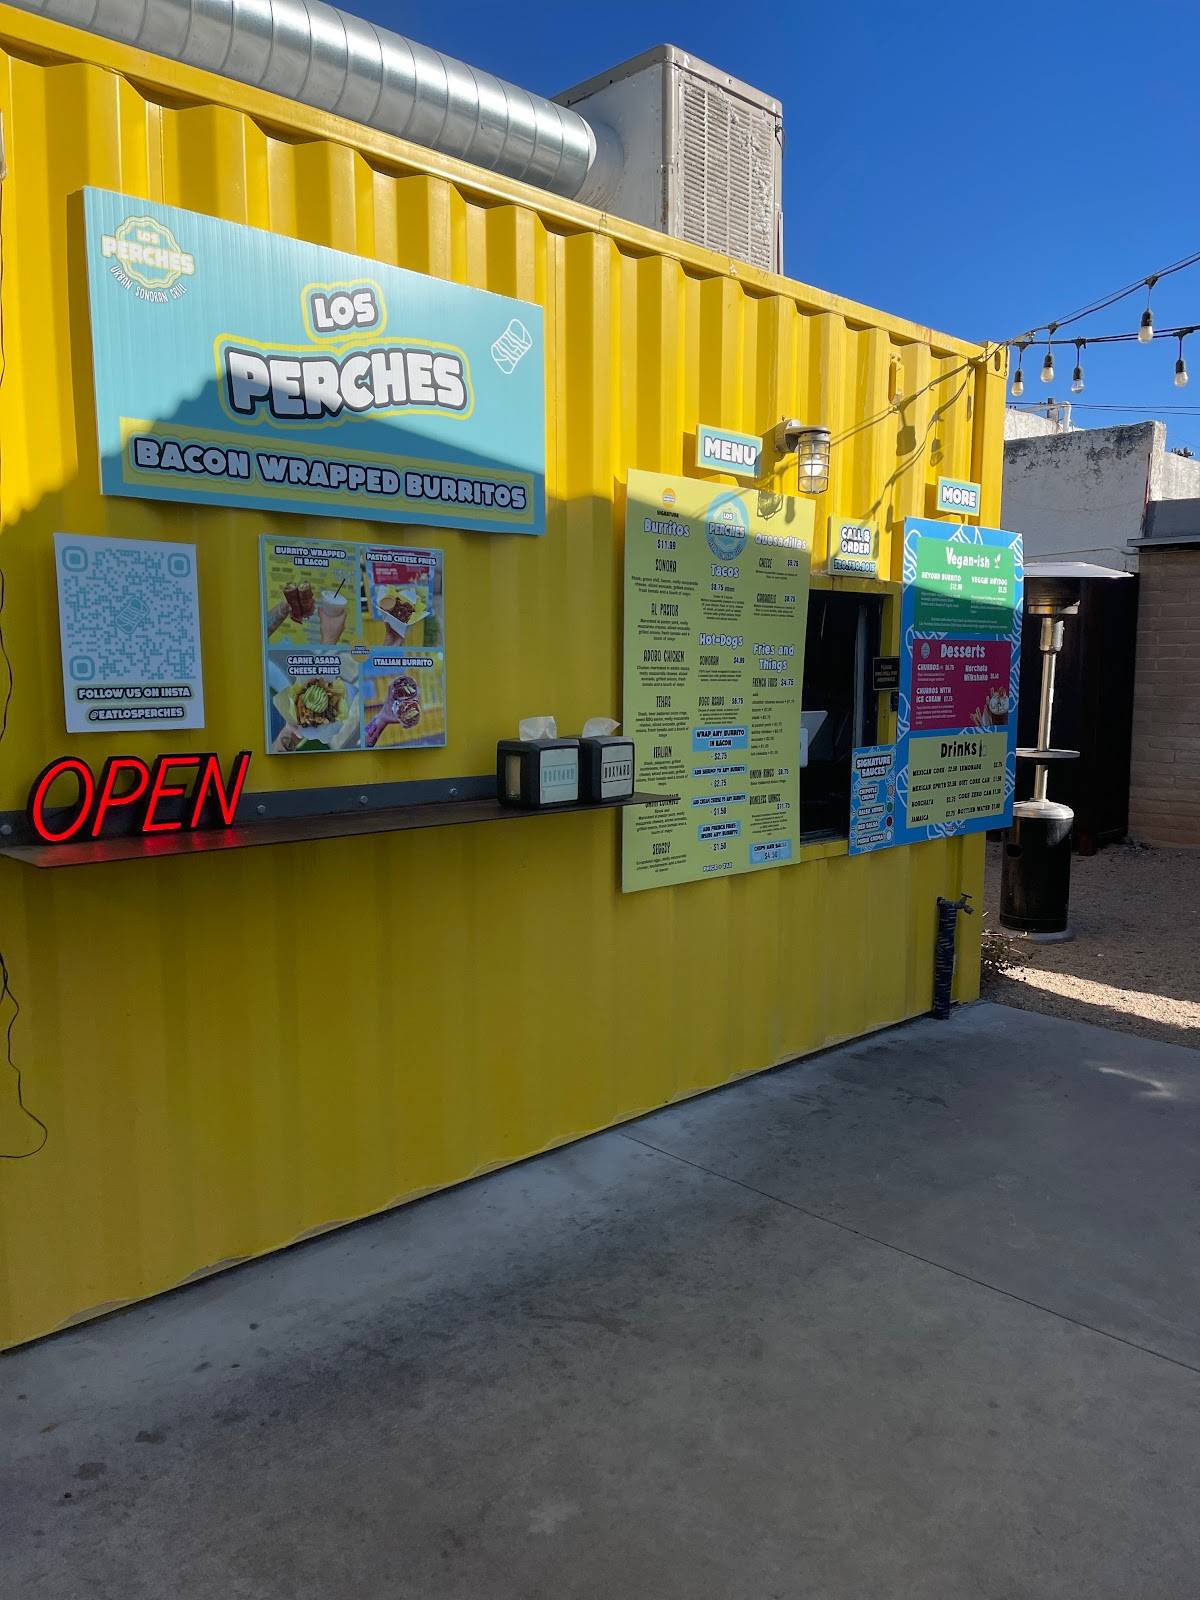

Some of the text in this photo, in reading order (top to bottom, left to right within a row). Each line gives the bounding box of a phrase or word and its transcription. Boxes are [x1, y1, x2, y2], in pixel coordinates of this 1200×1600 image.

[102, 234, 194, 275] PERCHES
[111, 265, 133, 290] URBAN
[136, 286, 168, 303] SONORAN
[311, 290, 378, 331] LOS
[225, 348, 467, 418] PERCHES
[703, 435, 757, 467] MENU
[134, 438, 526, 509] BACON WRAPPED BURRITOS
[941, 486, 976, 508] MORE
[723, 512, 733, 520] LOS
[643, 518, 691, 538] Burritos
[709, 522, 745, 538] PERCHES
[841, 527, 861, 541] CALL
[754, 534, 807, 549] Quesadillas
[841, 540, 870, 555] ORDER
[275, 545, 346, 559] BURRITO WRAPPED
[946, 547, 990, 568] Vegan-ish
[294, 557, 329, 567] IN BACON
[366, 553, 436, 566] PASTOR CHEESE FRIES
[711, 564, 739, 578] Tacos
[660, 604, 679, 616] PASTOR
[699, 633, 743, 650] Hot-Dogs
[643, 650, 661, 662] ADOBO
[752, 643, 795, 656] Fries and
[941, 644, 985, 658] Desserts
[287, 656, 341, 665] CARNE ASADA
[374, 658, 433, 667] ITALIAN BURRITO
[759, 659, 787, 672] Things
[288, 665, 341, 675] CHEESE FRIES
[78, 686, 192, 700] FOLLOW US ON INSTA
[89, 707, 184, 721] @EATLOSPERCHES
[696, 730, 711, 738] WRAP
[723, 729, 745, 737] BURRITO
[941, 741, 976, 758] Drinks
[856, 755, 891, 769] SIGNATURE
[604, 764, 630, 778] BOXYARD
[861, 767, 885, 778] SAUCES
[31, 753, 251, 844] OPEN
